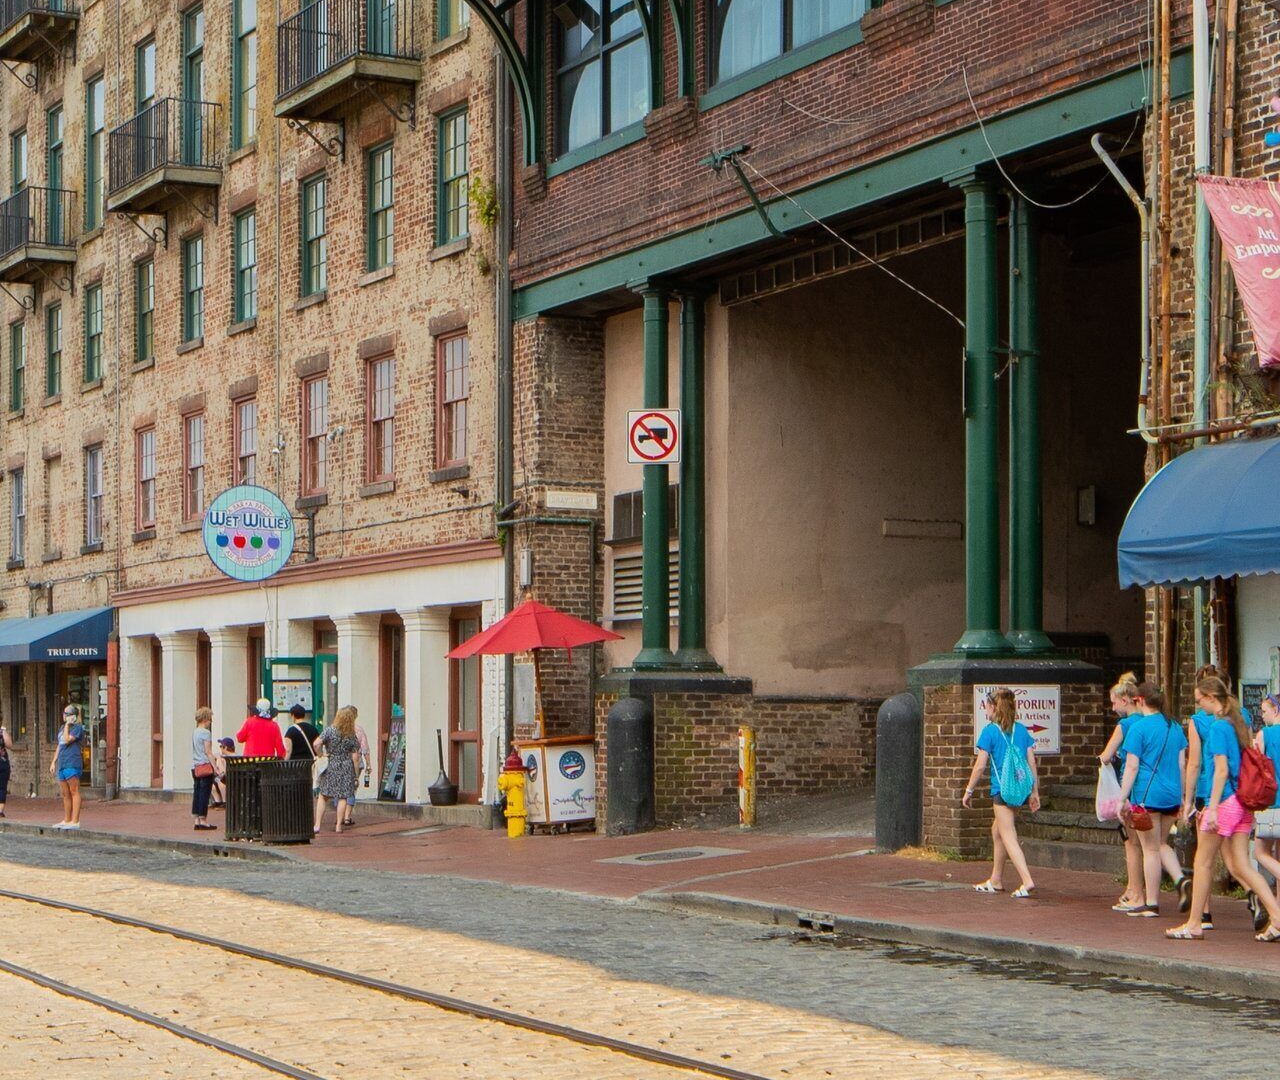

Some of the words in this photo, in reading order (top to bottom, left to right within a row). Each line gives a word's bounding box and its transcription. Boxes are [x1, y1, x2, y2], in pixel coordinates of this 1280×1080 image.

[1257, 226, 1278, 241] Art
[210, 511, 239, 526] WET
[47, 648, 71, 657] TRUE
[72, 647, 98, 656] GRITS
[1016, 699, 1056, 710] PORIUM
